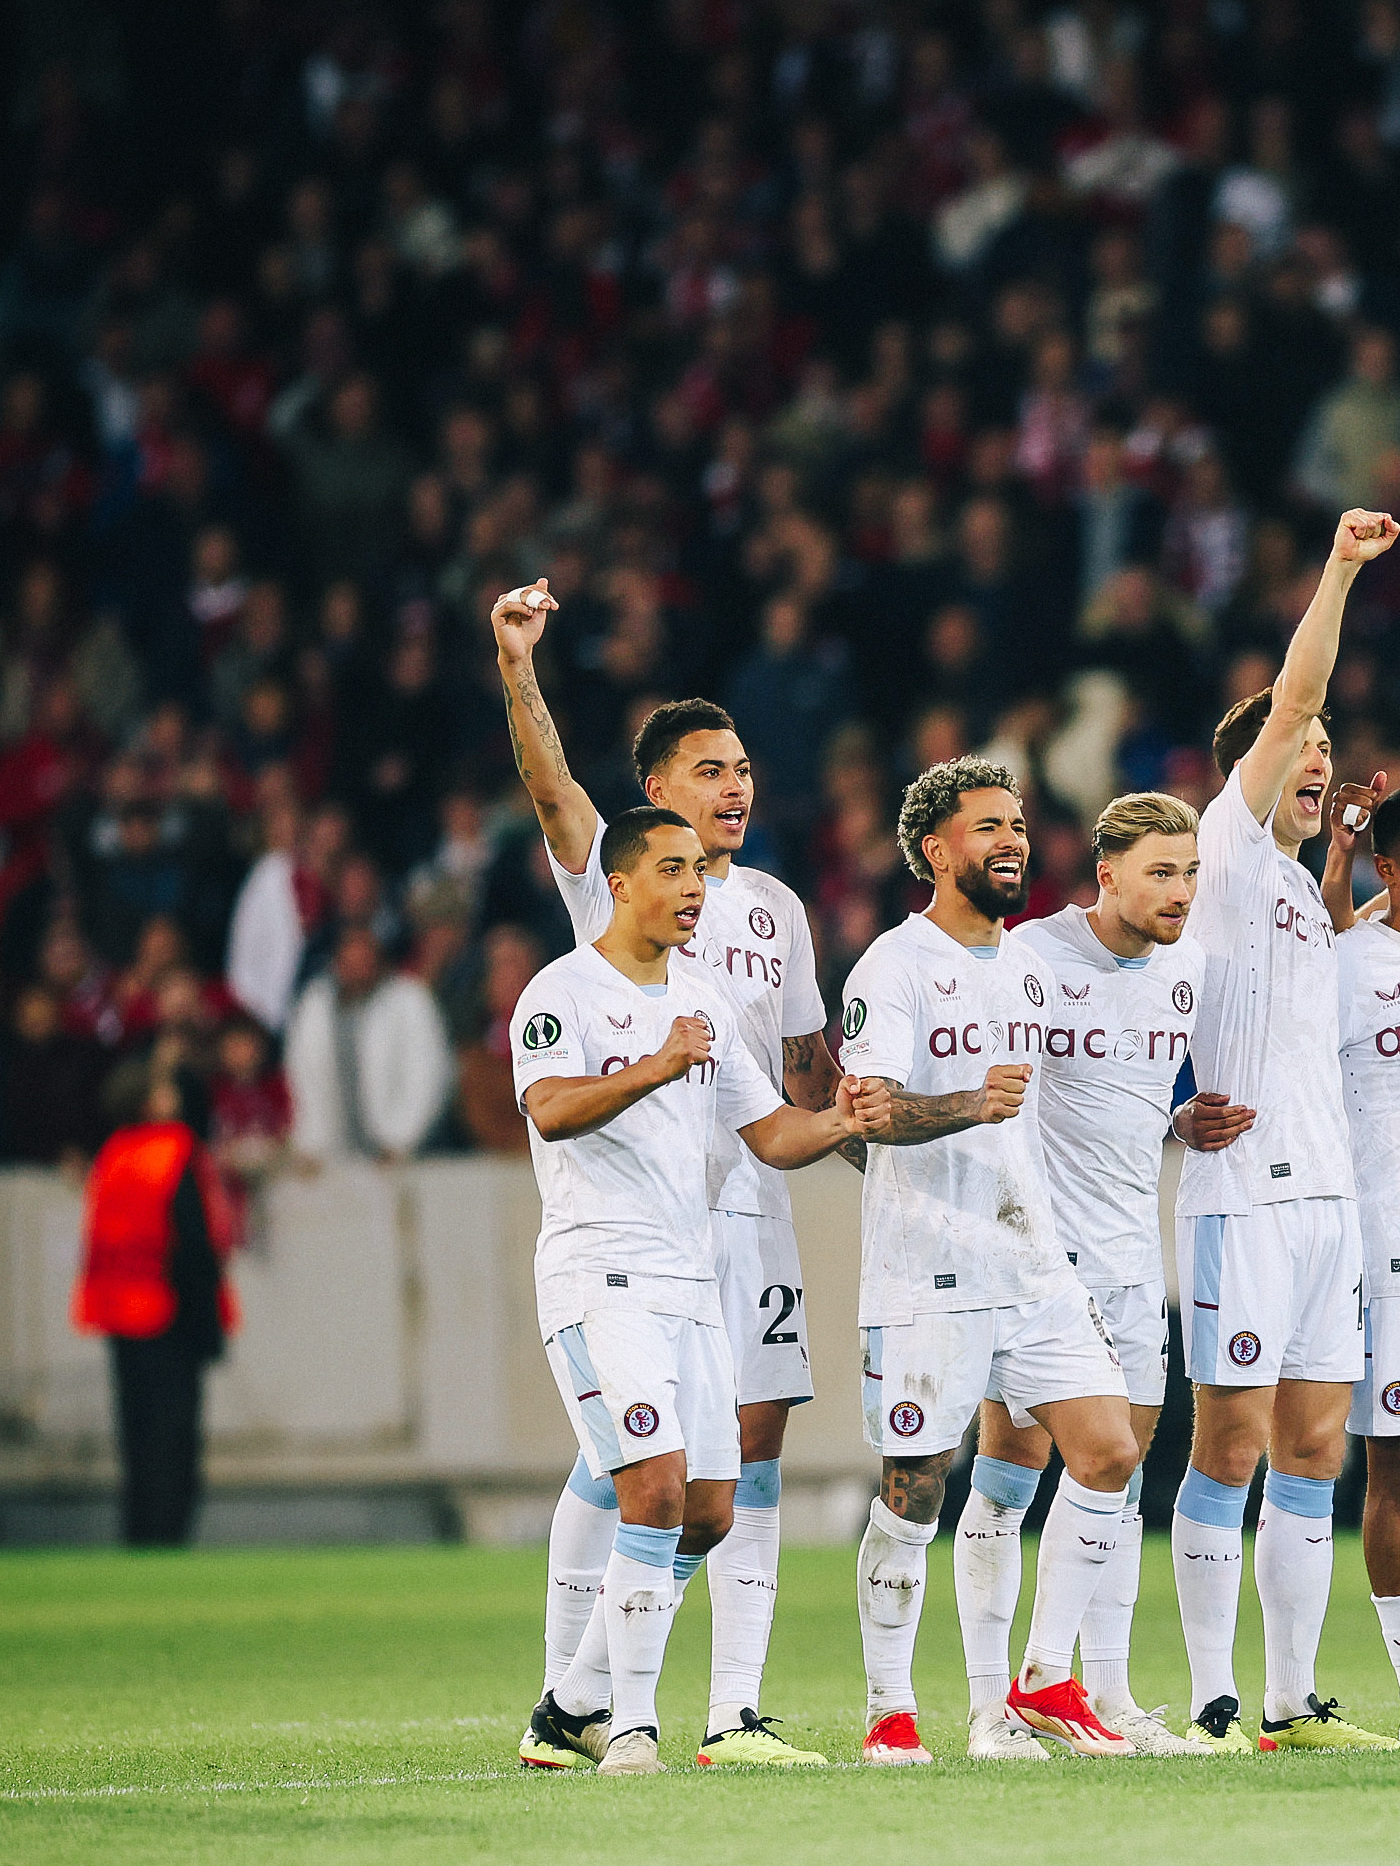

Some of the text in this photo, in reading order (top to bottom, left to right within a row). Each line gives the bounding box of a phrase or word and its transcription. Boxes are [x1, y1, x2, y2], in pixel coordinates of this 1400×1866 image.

[928, 1020, 1050, 1058] acorn
[1046, 1028, 1194, 1061] acorn
[759, 1285, 804, 1345] 2
[555, 1577, 595, 1592] VILL
[868, 1576, 921, 1590] VILLA
